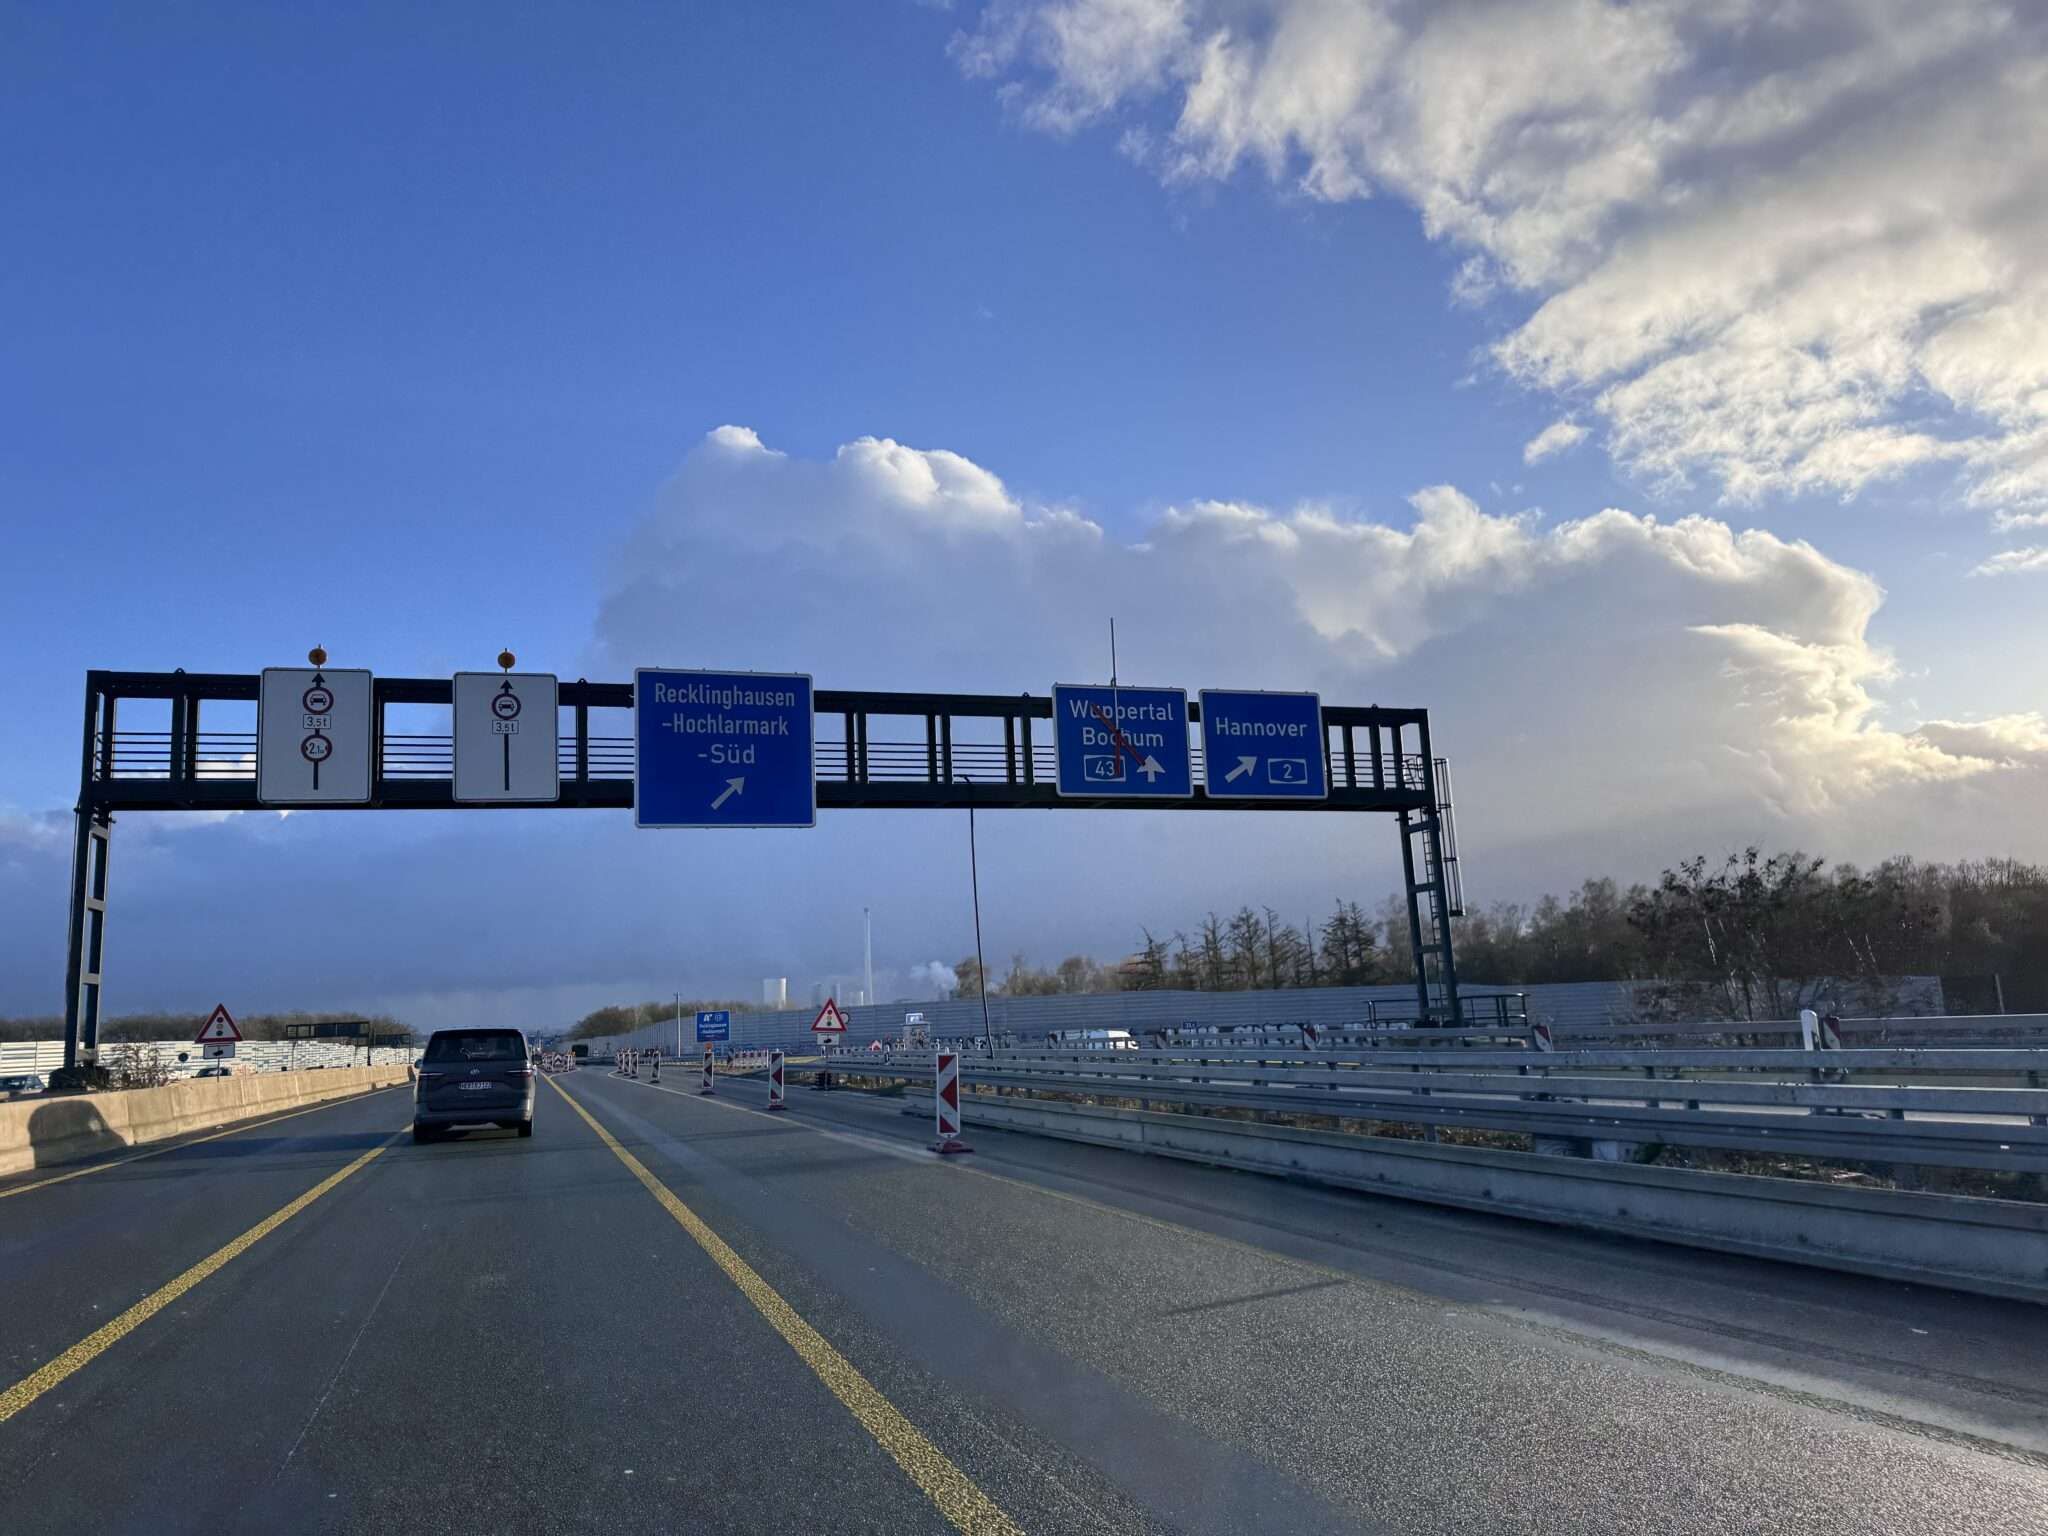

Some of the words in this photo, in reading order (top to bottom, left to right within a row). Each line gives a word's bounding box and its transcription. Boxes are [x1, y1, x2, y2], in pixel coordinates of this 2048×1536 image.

[655, 682, 795, 709] Recklinghausen
[662, 712, 789, 735] -Hochlarmark
[1216, 717, 1308, 737] Hannover
[1082, 727, 1163, 747] Bochum
[697, 743, 755, 764] -Süd
[1095, 760, 1115, 776] 43
[1282, 763, 1293, 779] 2
